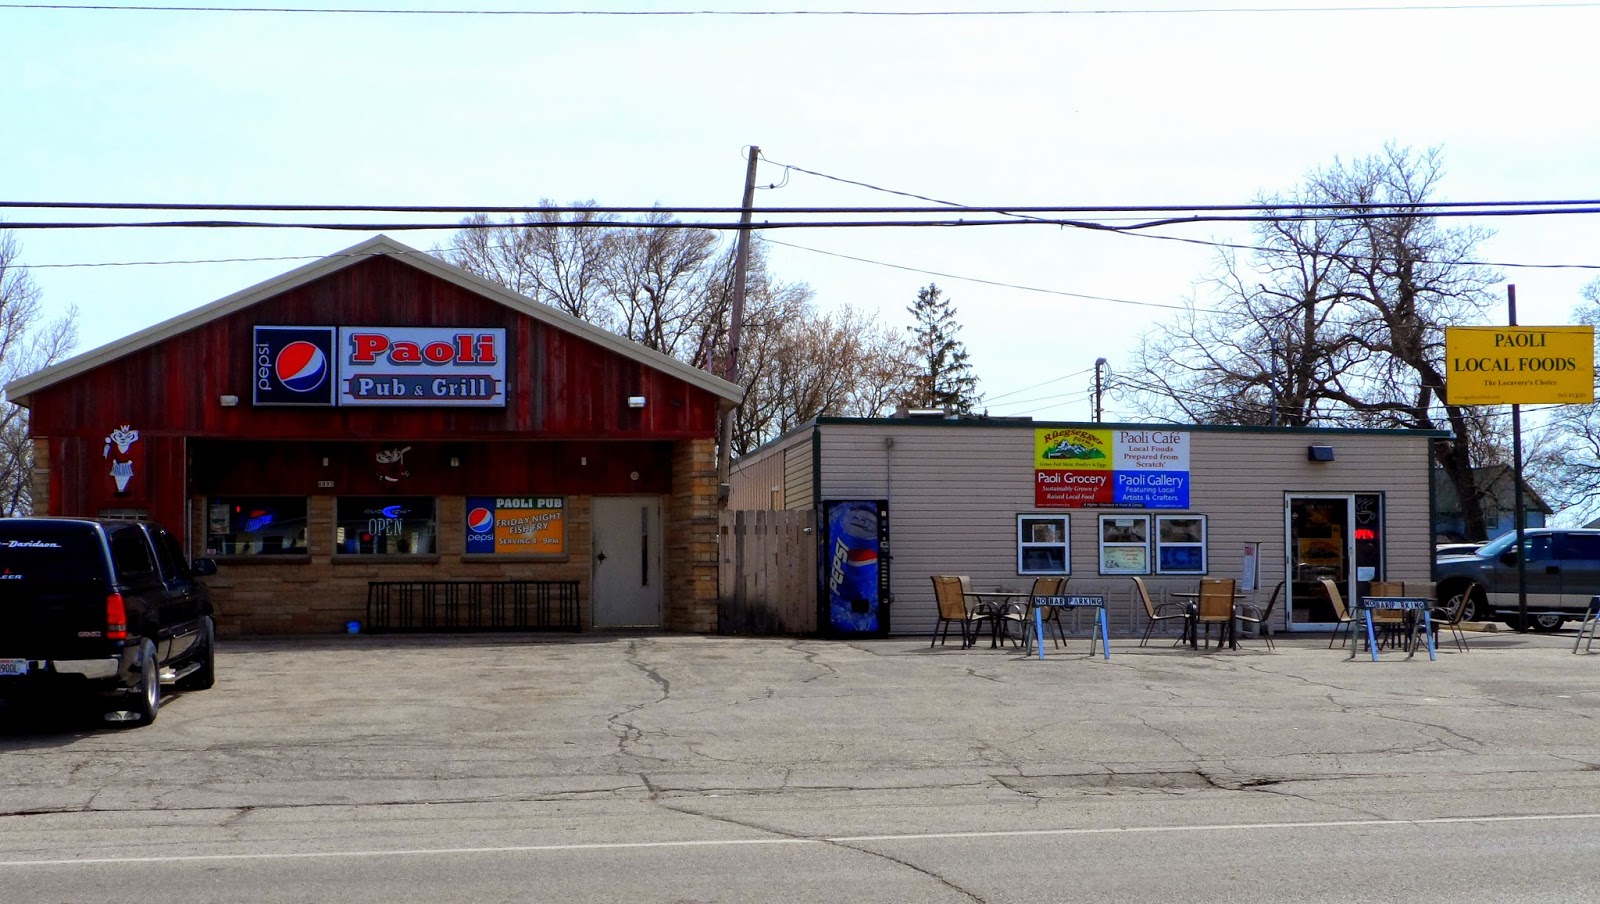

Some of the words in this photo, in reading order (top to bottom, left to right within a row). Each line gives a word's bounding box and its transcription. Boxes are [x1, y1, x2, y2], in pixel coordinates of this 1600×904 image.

[1494, 333, 1547, 347] PAOLI
[350, 333, 498, 365] Paoli
[256, 343, 272, 391] pepsi
[1454, 358, 1514, 372] LOCAL
[1519, 357, 1576, 371] FOODS
[358, 378, 406, 396] Pub
[414, 385, 424, 396] &
[432, 378, 487, 396] Grill
[1073, 436, 1095, 448] Farms
[1120, 432, 1149, 444] Paoli
[1152, 430, 1181, 444] Café
[1124, 453, 1157, 461] Prepared
[1038, 473, 1061, 483] Paoli
[1064, 473, 1107, 486] Grocery
[1119, 474, 1145, 485] Paoli
[1148, 475, 1184, 488] Gallery
[1042, 485, 1073, 493] Sustainably
[496, 498, 533, 508] PAOLI
[537, 498, 563, 508] PUB
[496, 517, 530, 527] FRIDAY
[532, 512, 562, 522] NIGHT
[368, 518, 403, 536] OPEN
[509, 525, 531, 535] FISH
[531, 522, 549, 531] FRY
[468, 532, 494, 542] pepsi
[499, 537, 531, 545] SERVING
[0, 540, 62, 548] -Davidson
[830, 537, 849, 596] PEPSI
[1035, 597, 1046, 605] NO
[1049, 597, 1065, 605] BAR
[1068, 597, 1102, 605] PARKING
[1364, 599, 1375, 607] NO
[1375, 601, 1390, 609] BAR
[1391, 601, 1425, 609] PRKING
